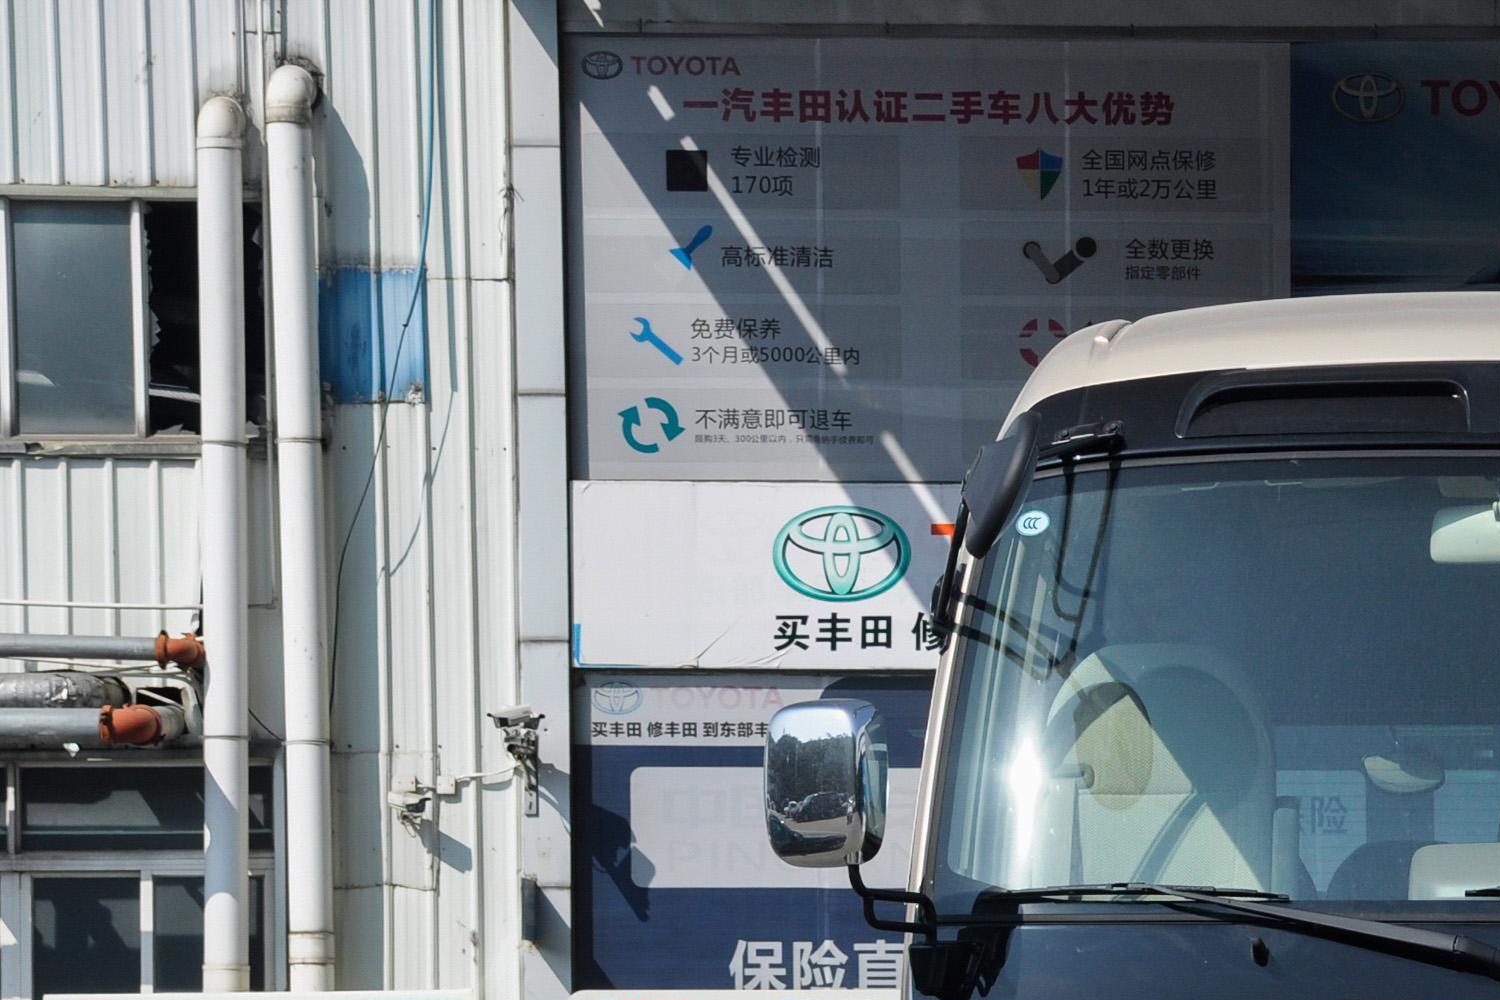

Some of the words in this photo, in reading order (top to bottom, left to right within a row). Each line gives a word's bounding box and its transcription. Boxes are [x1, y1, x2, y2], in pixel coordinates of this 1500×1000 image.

[630, 56, 740, 77] TOYOTA
[683, 88, 1174, 126] 一汽丰田认证二手车八大优势
[730, 146, 821, 169] 专业检测
[1081, 149, 1217, 173] 全国网点保修
[731, 174, 794, 197] 170项
[1082, 177, 1217, 200] 1年或2万公里
[720, 244, 834, 269] 高标准清洁
[1124, 237, 1215, 261] 全数更换
[1124, 265, 1201, 282] 指定零部件
[690, 317, 782, 340] 免费保养
[691, 345, 861, 367] 3个月或5000公里内
[694, 408, 852, 432] 不满意即可退车
[773, 613, 893, 652] 买丰田
[591, 722, 642, 739] 买丰田
[647, 722, 698, 739] 修丰田
